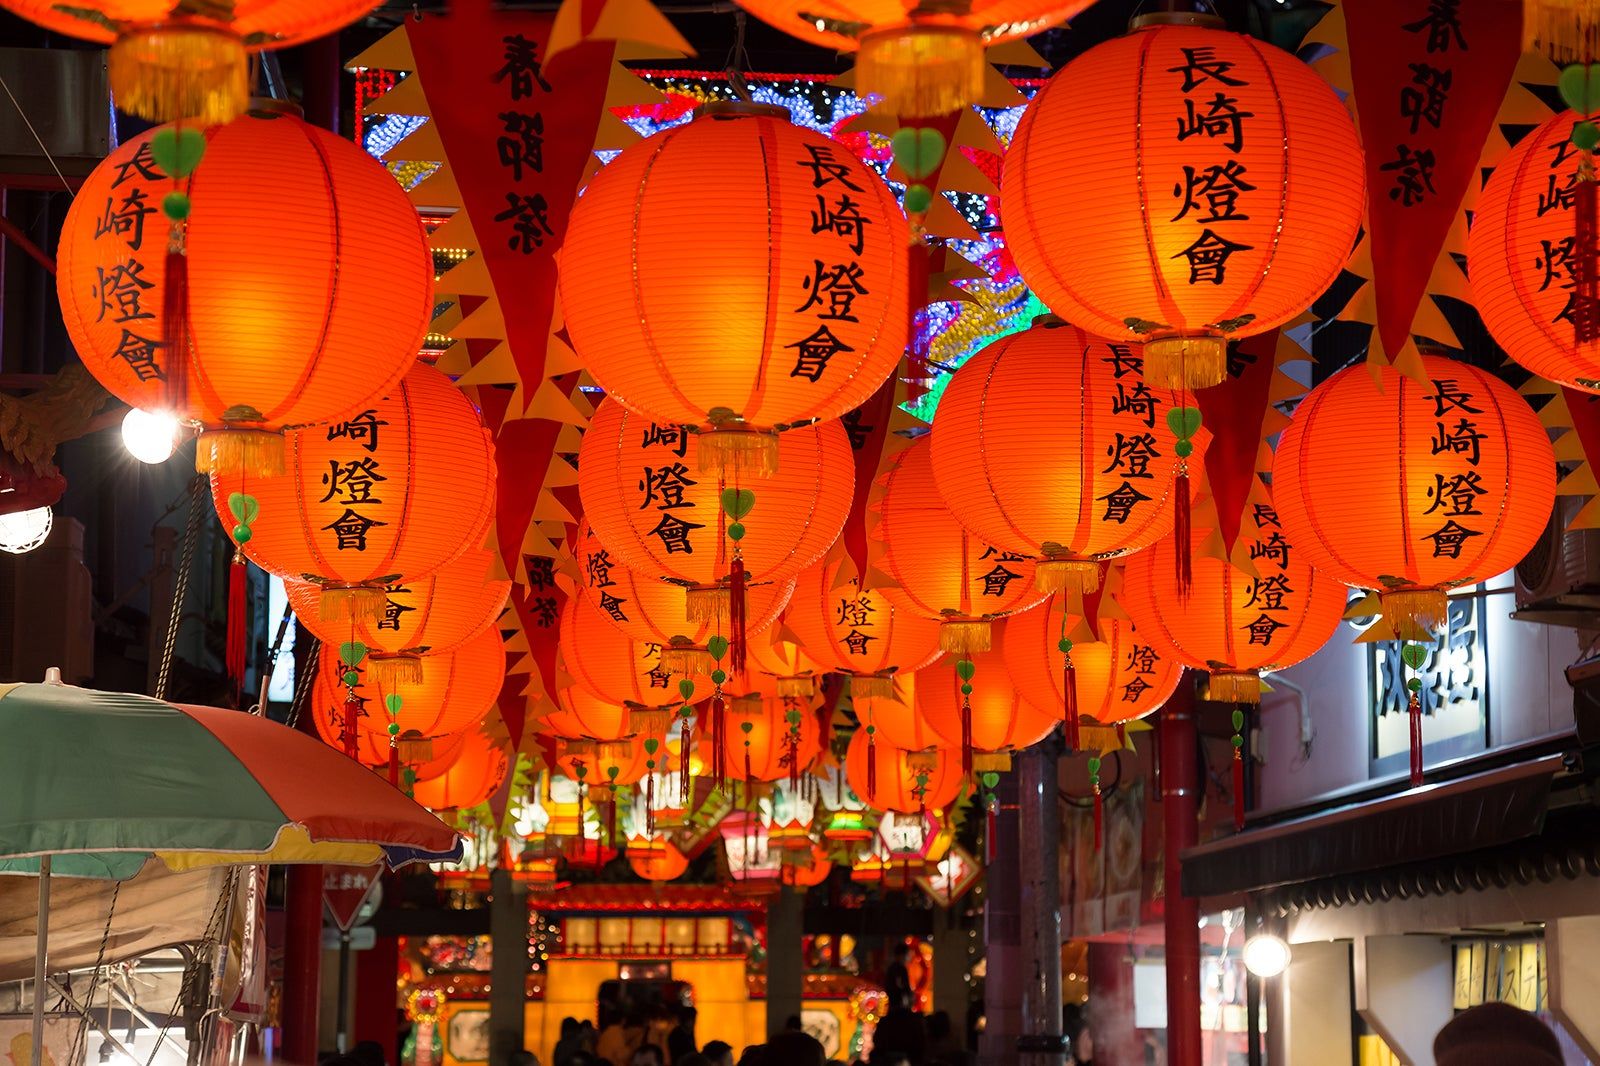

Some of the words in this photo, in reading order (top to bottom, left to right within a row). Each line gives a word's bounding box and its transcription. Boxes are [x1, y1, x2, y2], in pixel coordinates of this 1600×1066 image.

[1167, 46, 1257, 285] 長崎燈會
[93, 142, 169, 382] 長崎燈會
[784, 143, 872, 383] 長崎燈會
[1096, 343, 1162, 525] 長崎燈會
[1421, 379, 1488, 559] 長崎燈會
[586, 526, 629, 622] 燈會
[836, 575, 879, 656] 燈會
[1121, 621, 1161, 703] 燈會
[1240, 503, 1294, 646] 長崎燈會
